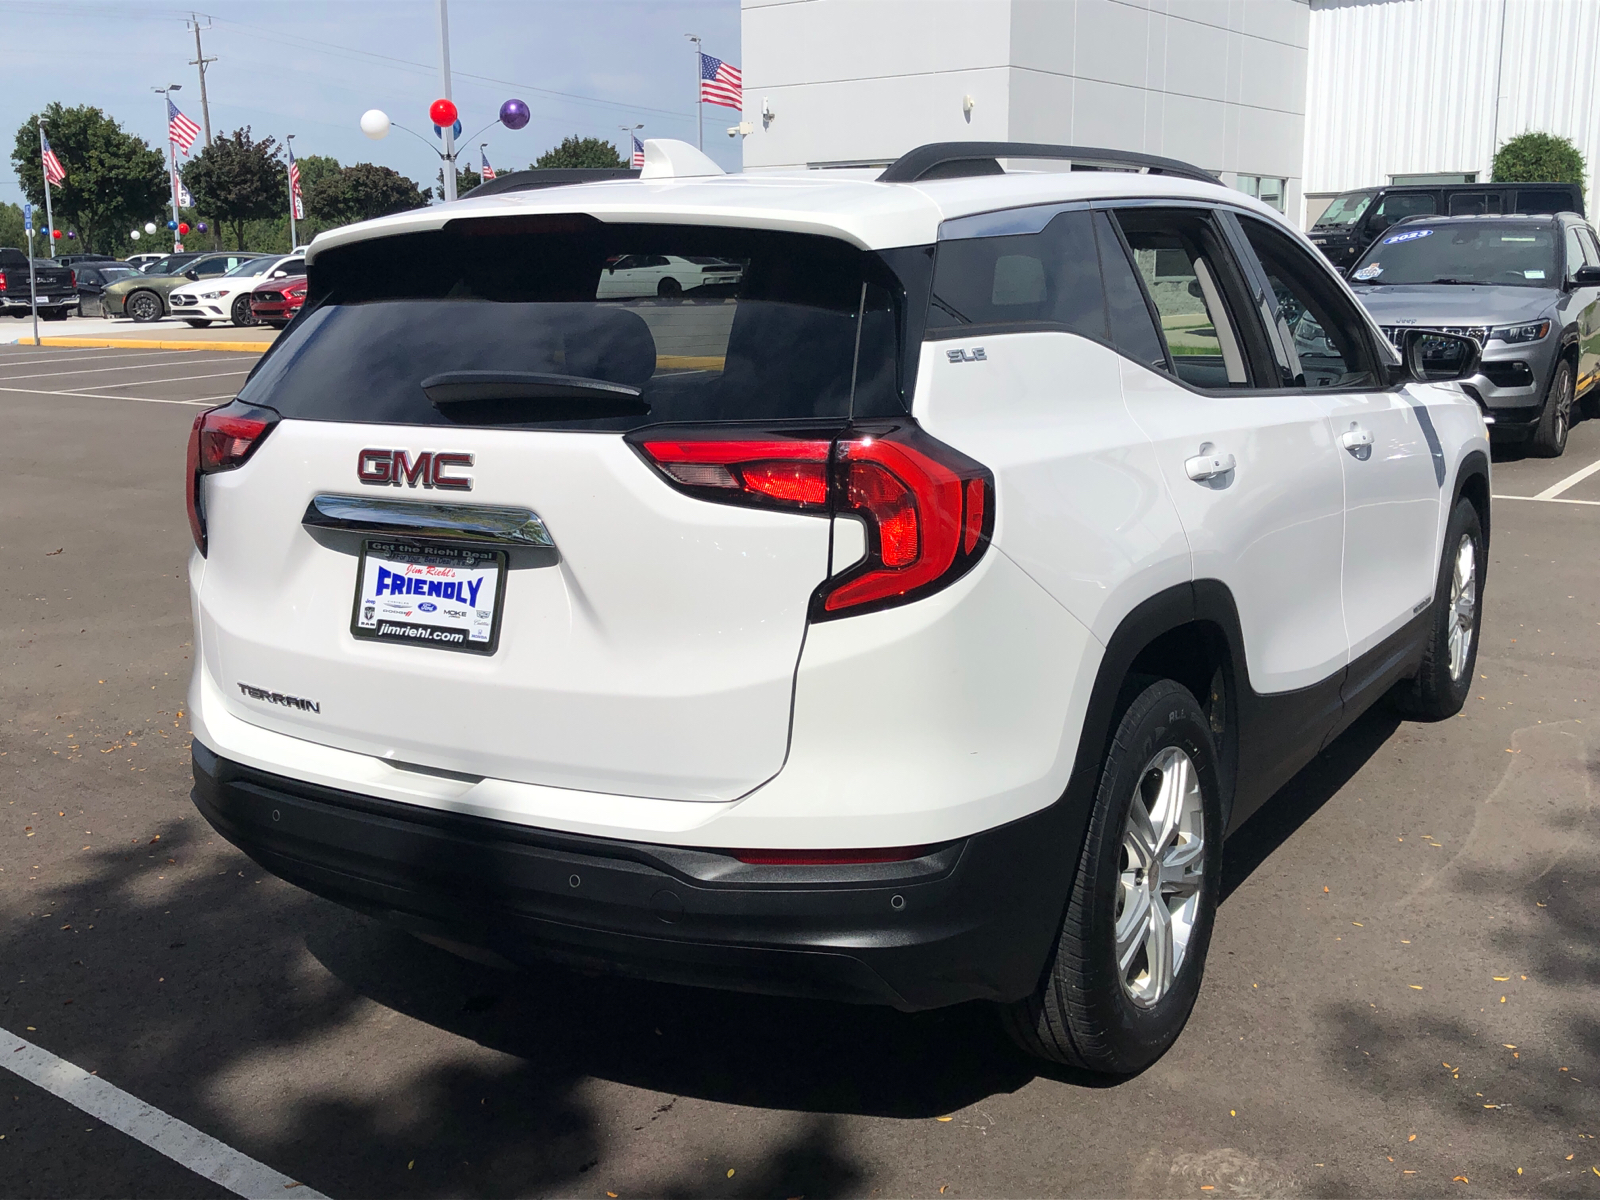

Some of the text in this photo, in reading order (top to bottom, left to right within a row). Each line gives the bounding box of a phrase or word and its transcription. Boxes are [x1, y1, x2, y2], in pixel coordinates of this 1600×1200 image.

[1389, 230, 1429, 242] 2023
[1395, 317, 1417, 325] Jeep
[946, 347, 988, 363] SLE
[357, 448, 475, 491] GMC
[372, 542, 492, 559] Get the Riehl Deal
[405, 563, 456, 578] Jim Riehl's
[375, 565, 484, 608] FRIENDLY
[443, 609, 467, 617] MOKE
[377, 623, 464, 643] jimriehl.com
[236, 682, 321, 714] TERRAIN
